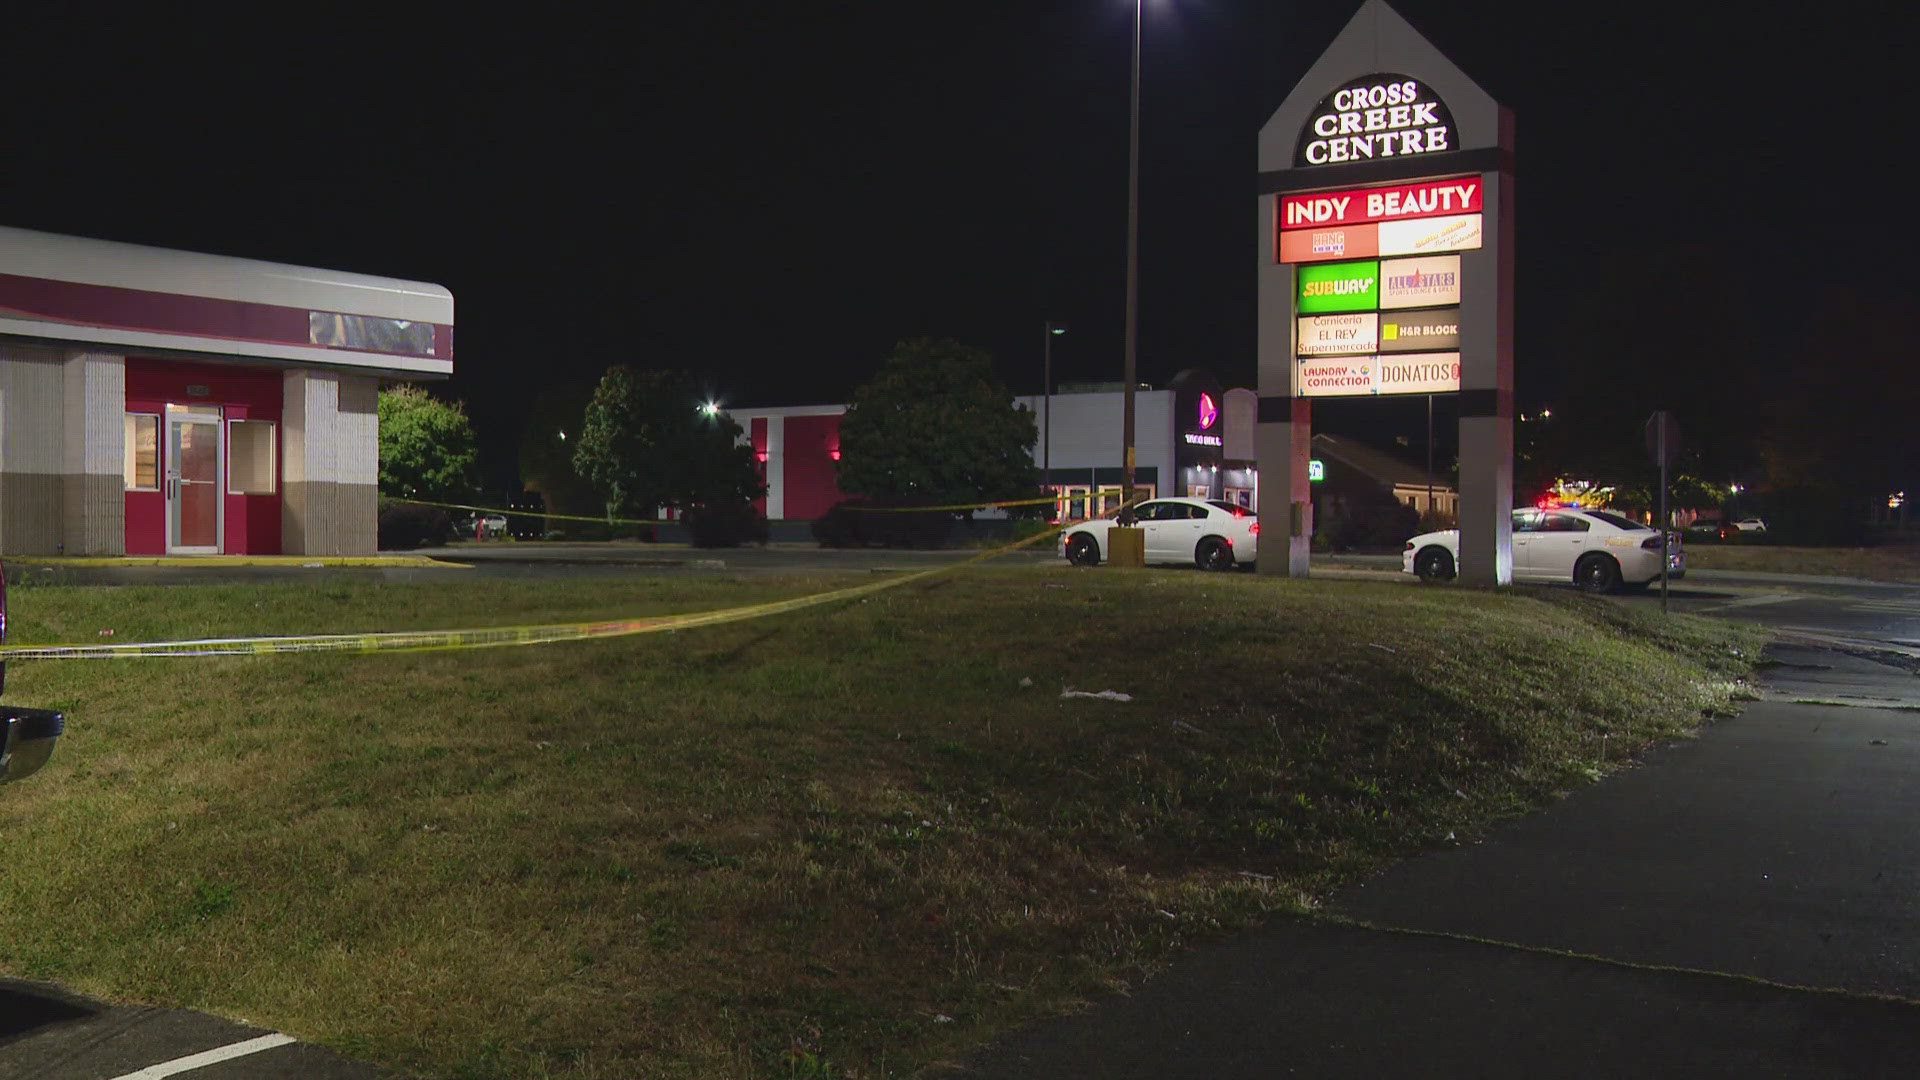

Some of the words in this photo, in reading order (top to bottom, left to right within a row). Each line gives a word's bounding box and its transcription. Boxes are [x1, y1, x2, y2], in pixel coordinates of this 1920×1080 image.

[1334, 81, 1418, 112] CROSS
[1314, 101, 1439, 137] CREEK
[1305, 126, 1448, 164] CENTRE
[1287, 197, 1350, 225] INDY
[1367, 184, 1476, 218] BEAUTY
[1312, 231, 1345, 246] HANG
[1303, 278, 1373, 297] SUBWAY
[1418, 273, 1455, 287] STARS
[1313, 316, 1362, 326] Carniceria
[1319, 331, 1332, 341] EL
[1335, 329, 1357, 340] REY
[1400, 327, 1421, 337] H&R
[1422, 325, 1458, 336] BLOCK
[1303, 367, 1348, 377] LAUNDRY
[1382, 364, 1450, 383] DONATOS
